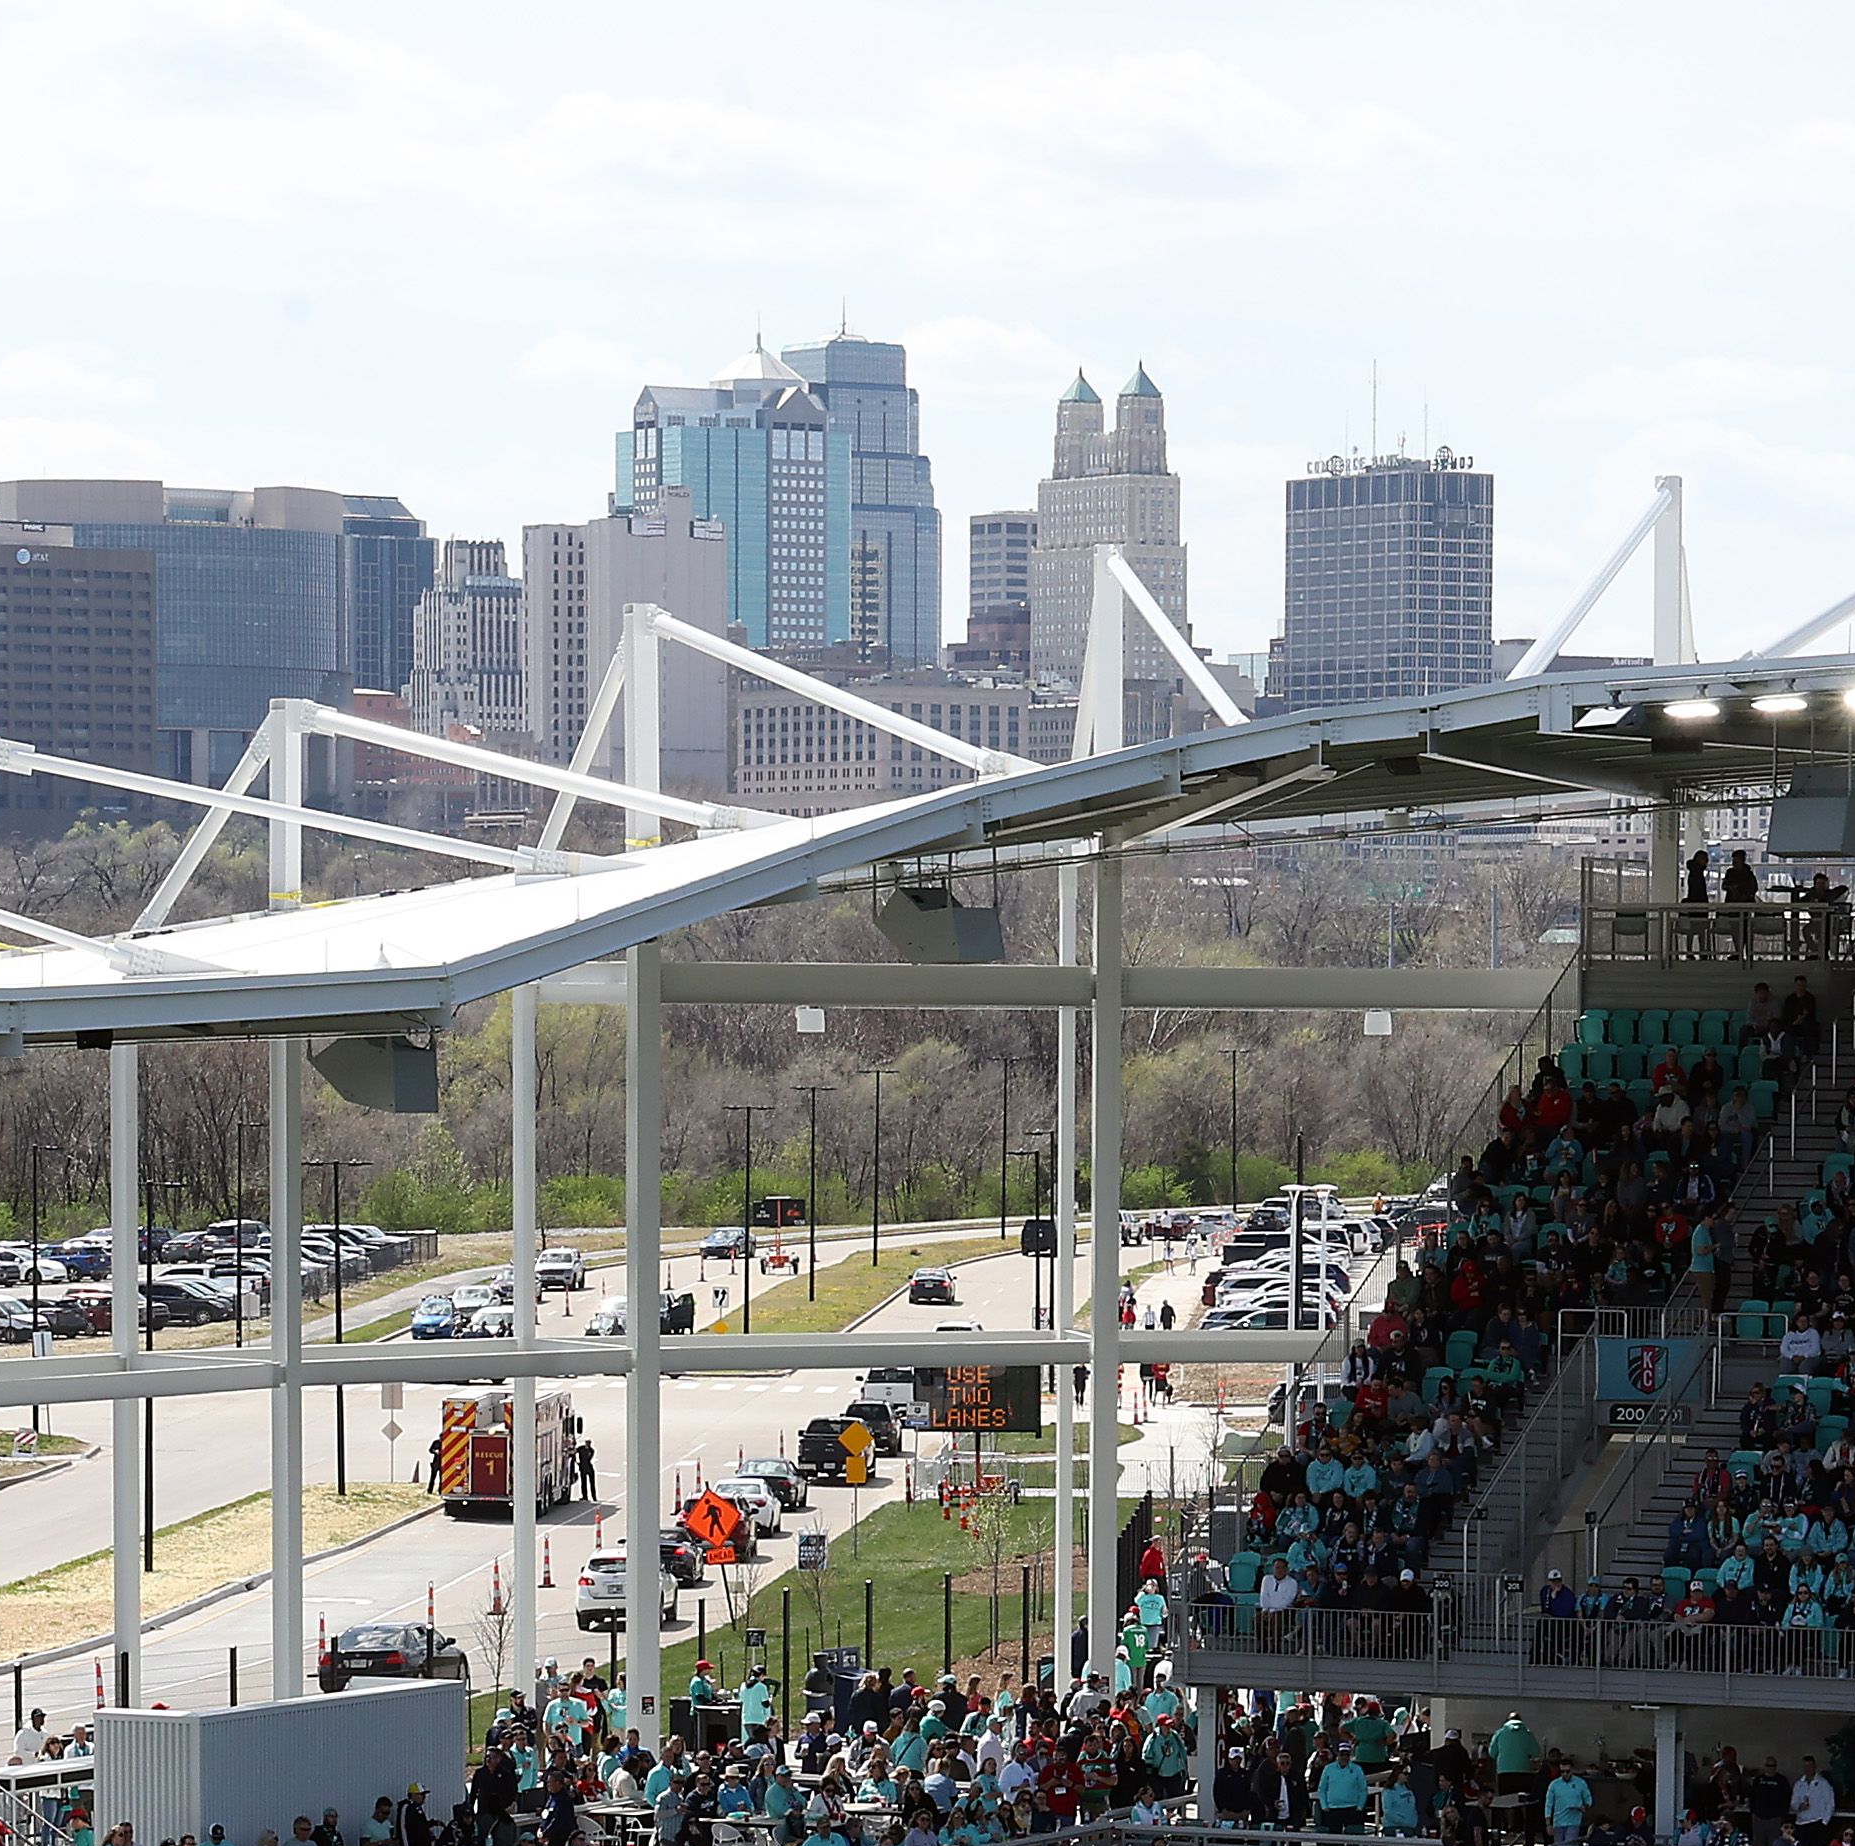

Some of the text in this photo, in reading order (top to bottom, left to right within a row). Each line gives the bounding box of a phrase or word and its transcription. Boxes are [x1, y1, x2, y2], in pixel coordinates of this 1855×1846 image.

[947, 1365, 991, 1384] USE
[947, 1387, 991, 1406] TWO
[932, 1408, 1006, 1427] LANES
[1616, 1408, 1645, 1421] 200
[485, 1460, 495, 1476] 1
[708, 1549, 733, 1562] AHEAD
[1134, 1633, 1145, 1648] 18
